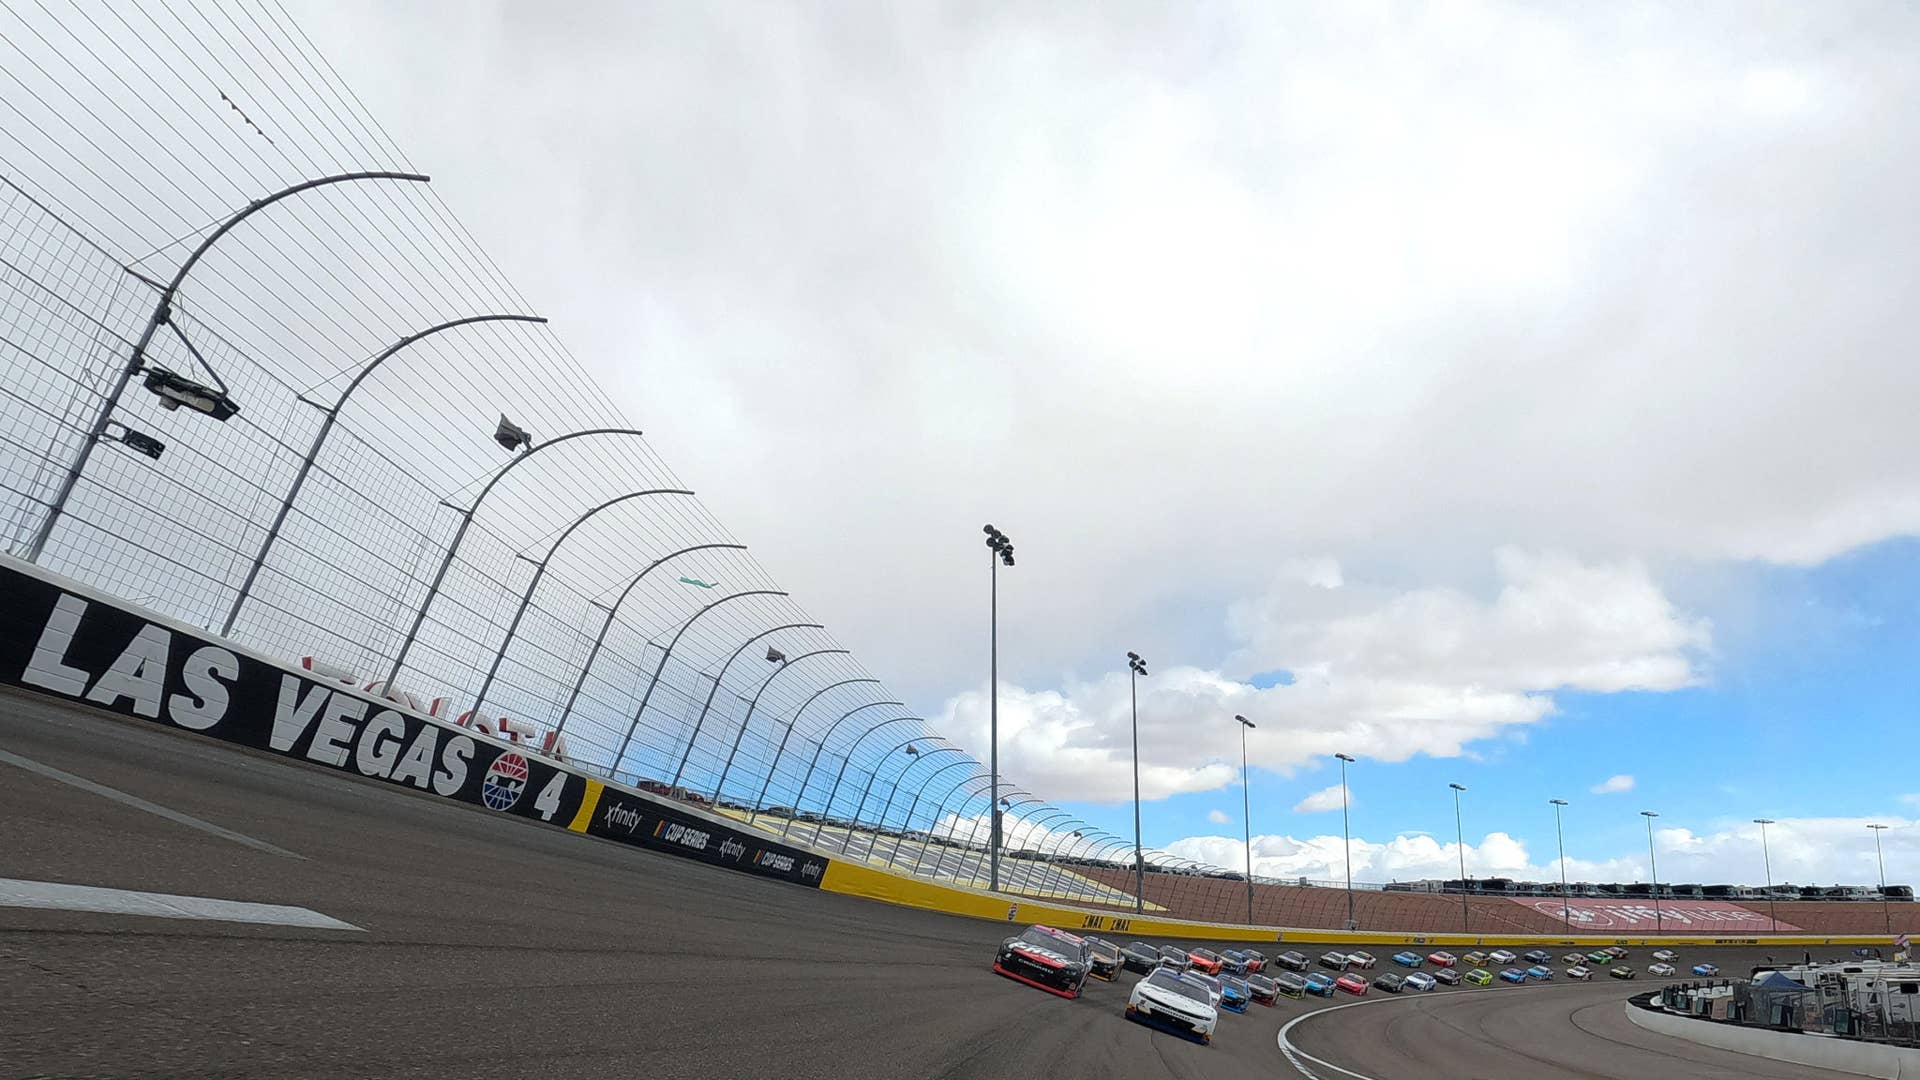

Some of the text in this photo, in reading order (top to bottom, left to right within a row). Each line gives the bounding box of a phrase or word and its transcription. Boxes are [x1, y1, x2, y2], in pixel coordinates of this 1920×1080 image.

[22, 592, 569, 821] LAS VEGAS 4
[604, 802, 642, 834] xfinity
[664, 823, 710, 850] CUP SERIES
[719, 837, 746, 862] xfinity
[801, 860, 821, 880] xfinity
